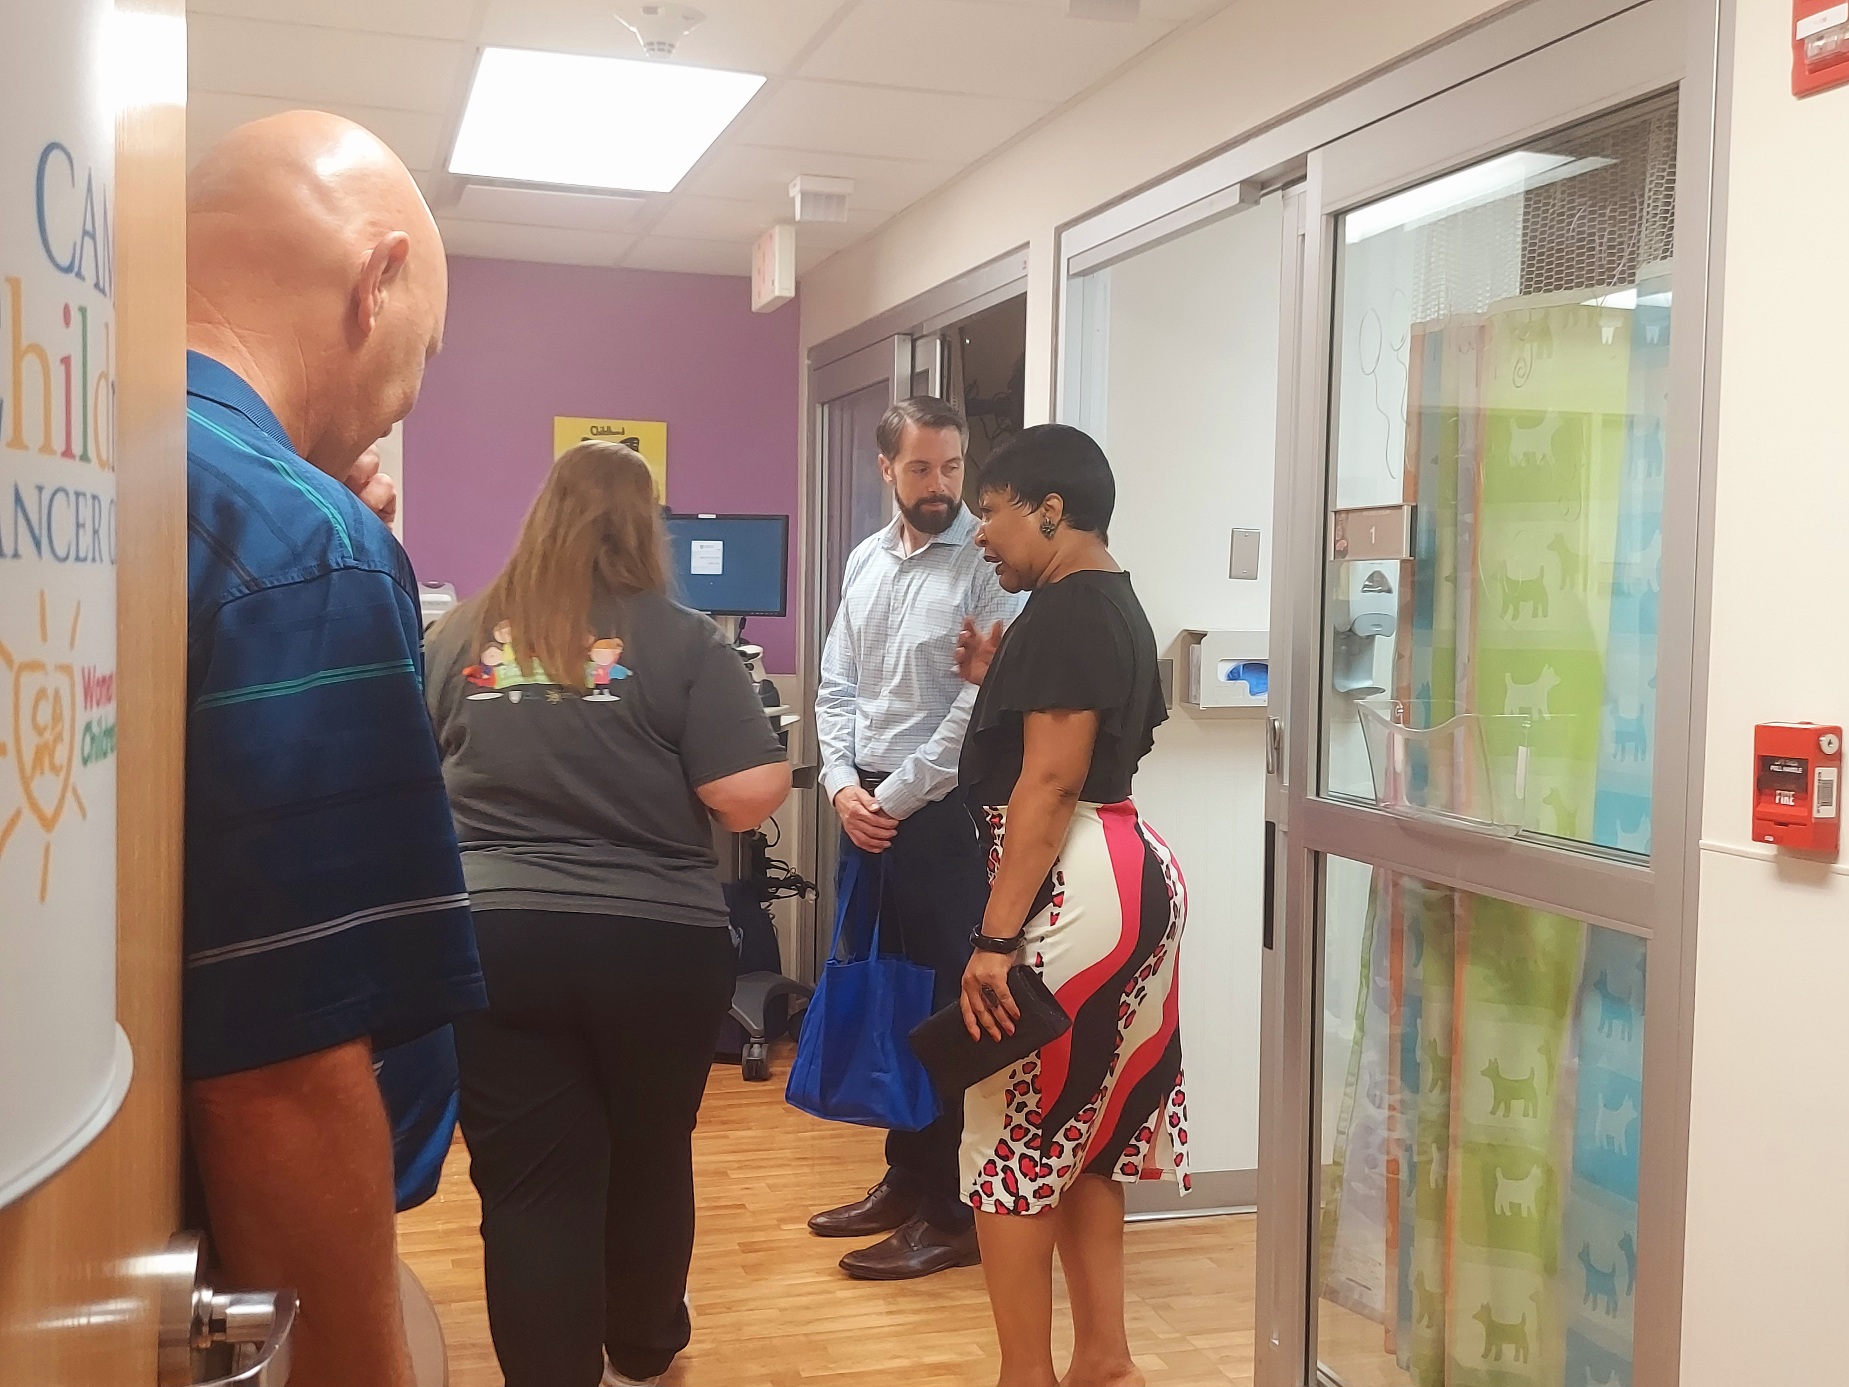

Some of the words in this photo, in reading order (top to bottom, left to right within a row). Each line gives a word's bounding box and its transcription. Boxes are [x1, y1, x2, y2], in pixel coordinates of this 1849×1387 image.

[0, 274, 115, 472] hild
[0, 480, 103, 564] NCER
[1370, 526, 1376, 544] 1
